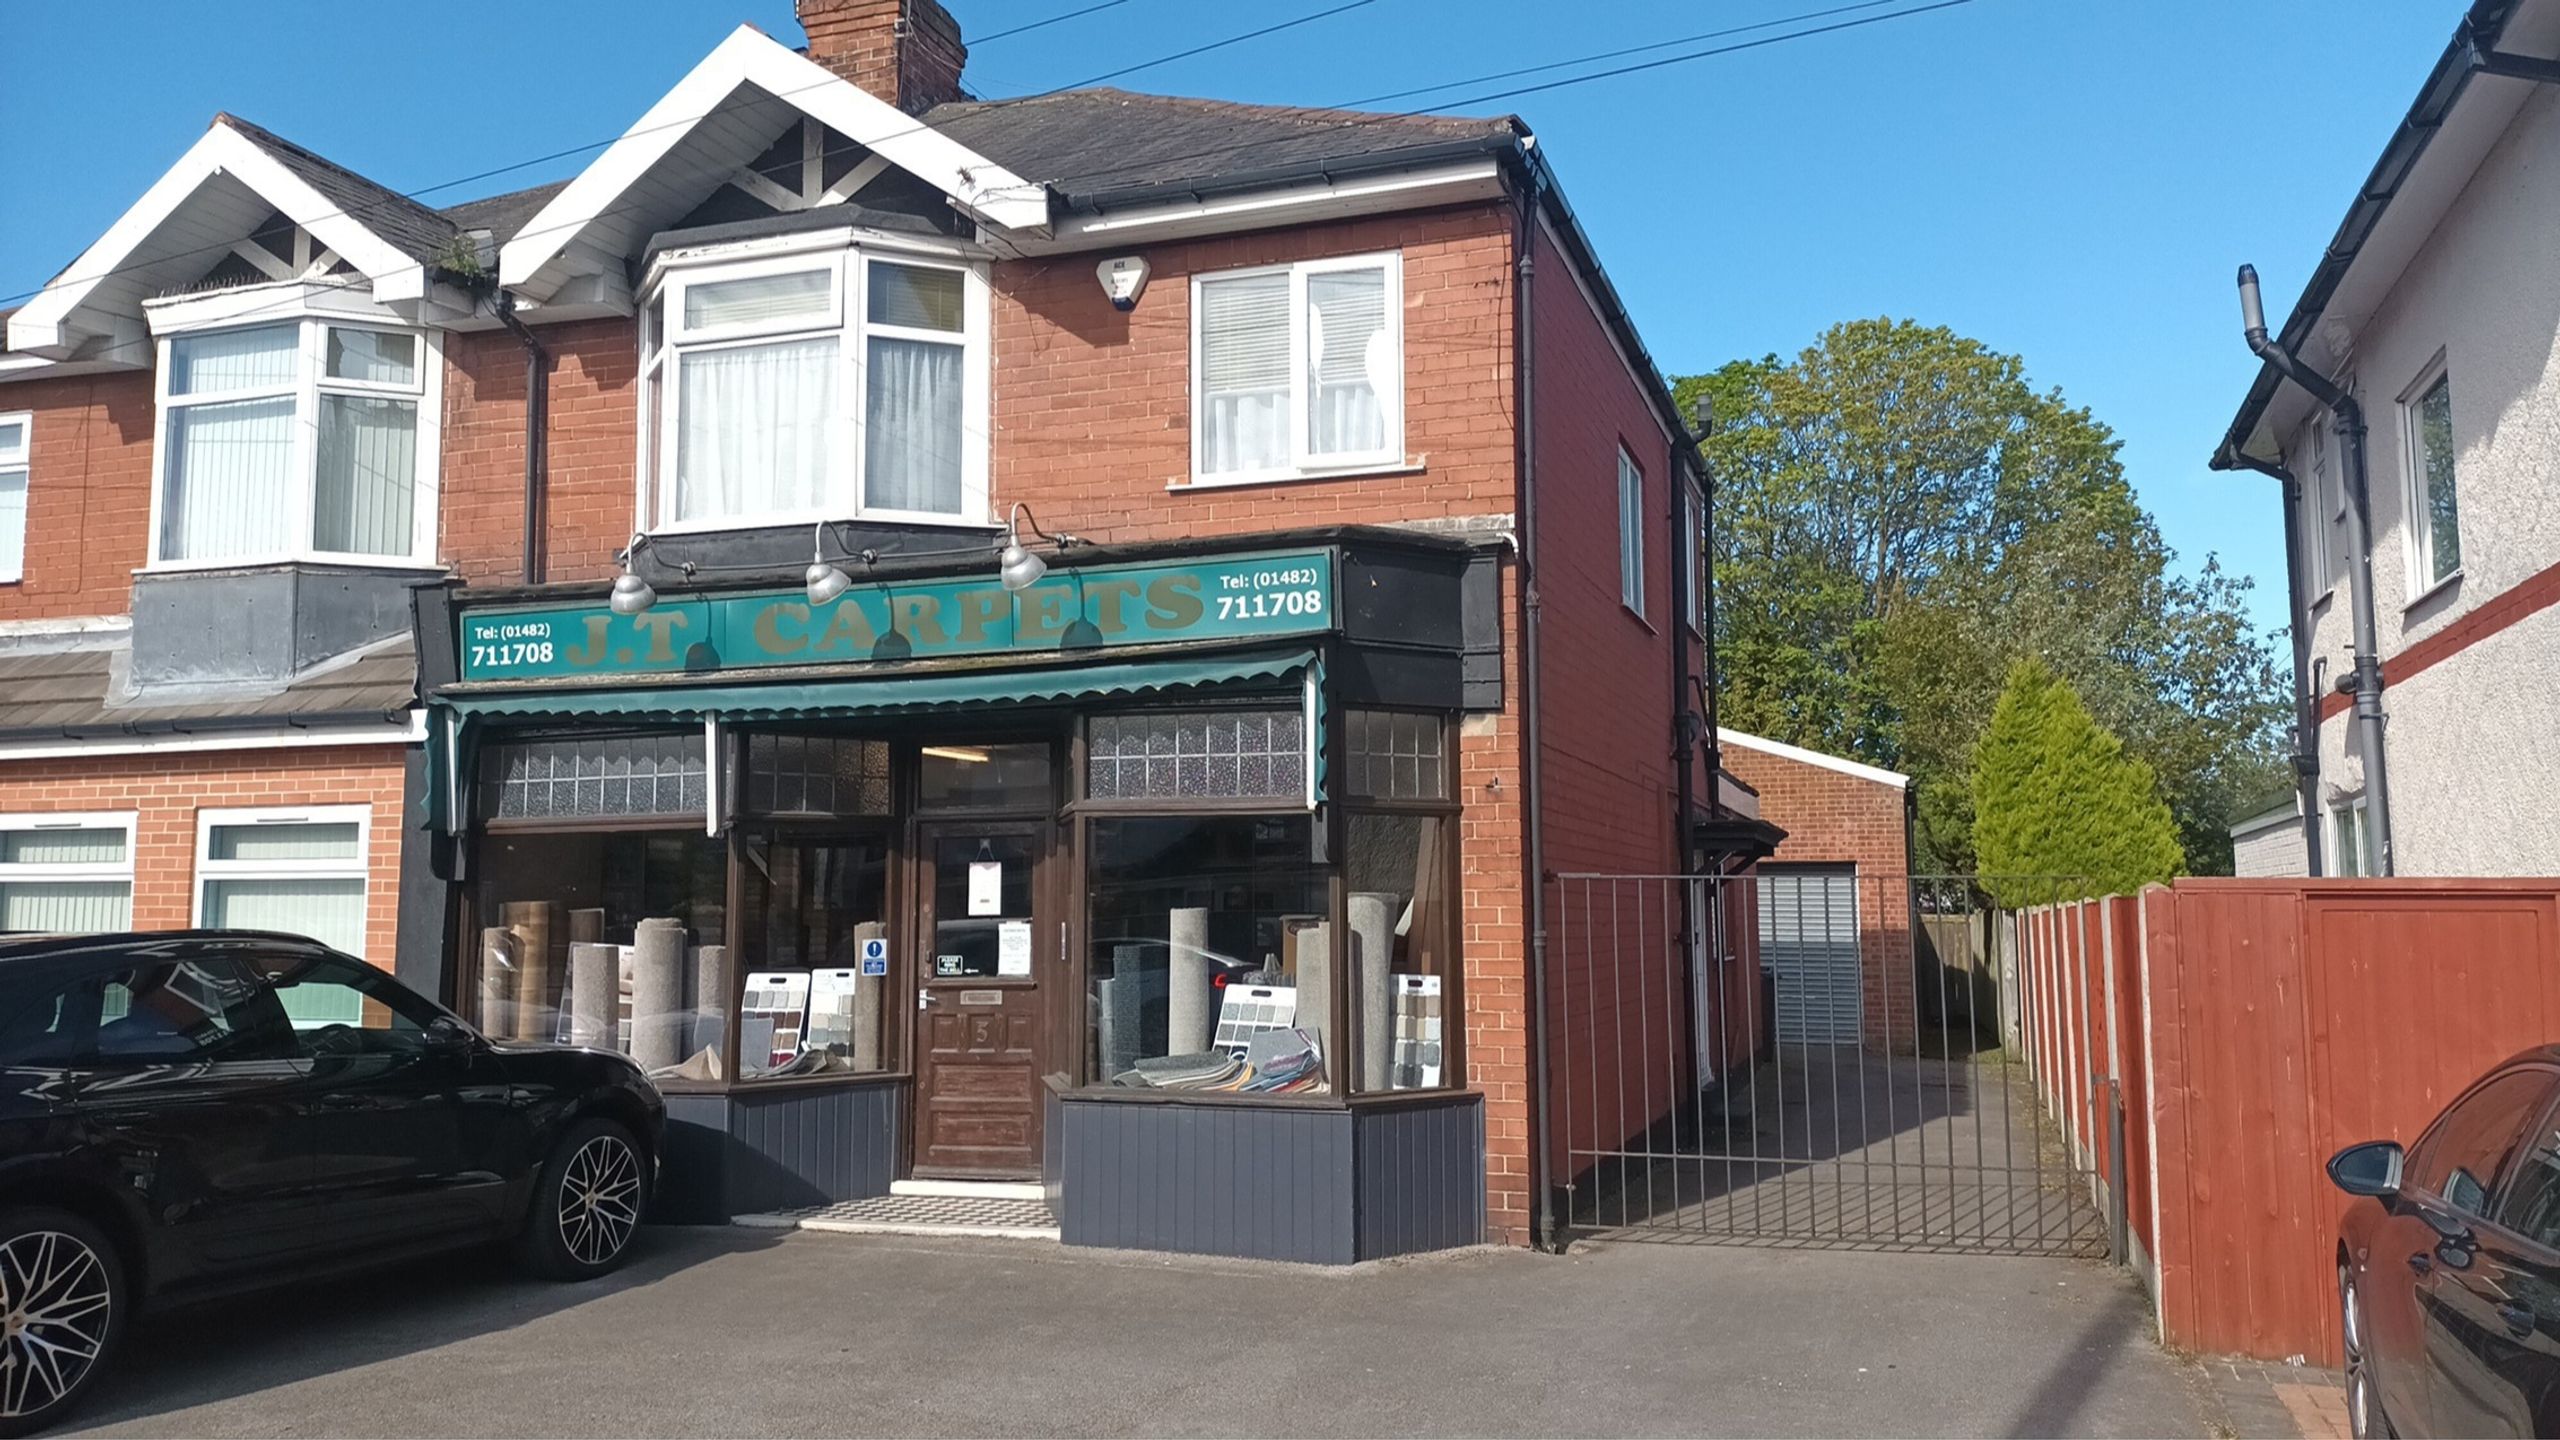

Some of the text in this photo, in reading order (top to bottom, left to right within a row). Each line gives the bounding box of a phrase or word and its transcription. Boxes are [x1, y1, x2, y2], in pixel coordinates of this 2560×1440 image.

[1219, 568, 1318, 591] Tel: (01482)
[1216, 590, 1322, 621] 711708
[475, 622, 551, 641] Tel: (01482)
[564, 574, 1205, 666] J.T CARPETS
[471, 642, 554, 667] 711708
